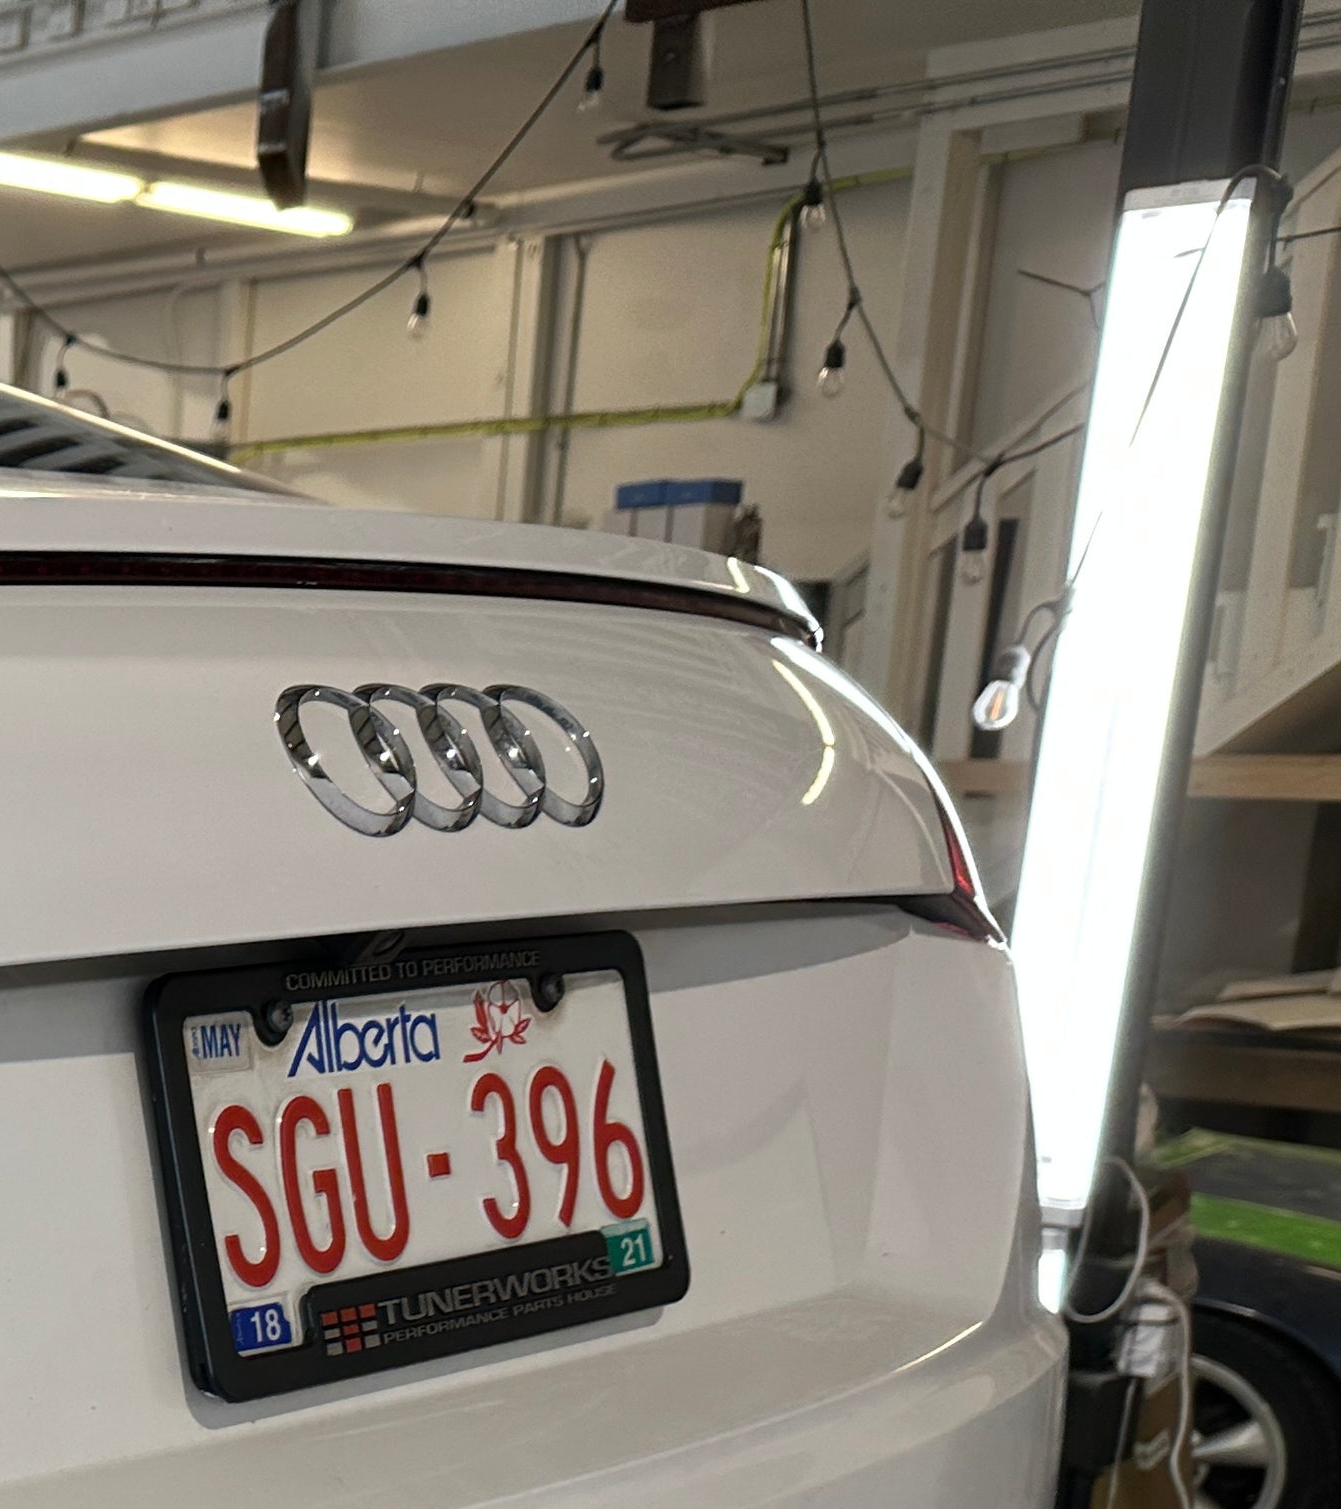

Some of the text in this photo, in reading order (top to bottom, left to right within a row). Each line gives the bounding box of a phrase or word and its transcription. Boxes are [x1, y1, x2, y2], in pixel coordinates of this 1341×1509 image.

[285, 950, 541, 991] COMMITTED TO PERFORMANCE
[201, 1023, 241, 1059] MAY
[287, 1000, 441, 1078] Alberta
[621, 1233, 646, 1267] 21
[377, 1256, 614, 1326] TUNERWORKS
[250, 1308, 281, 1343] 18
[383, 1283, 617, 1345] PERFORMANCE PARTS HOUSE
